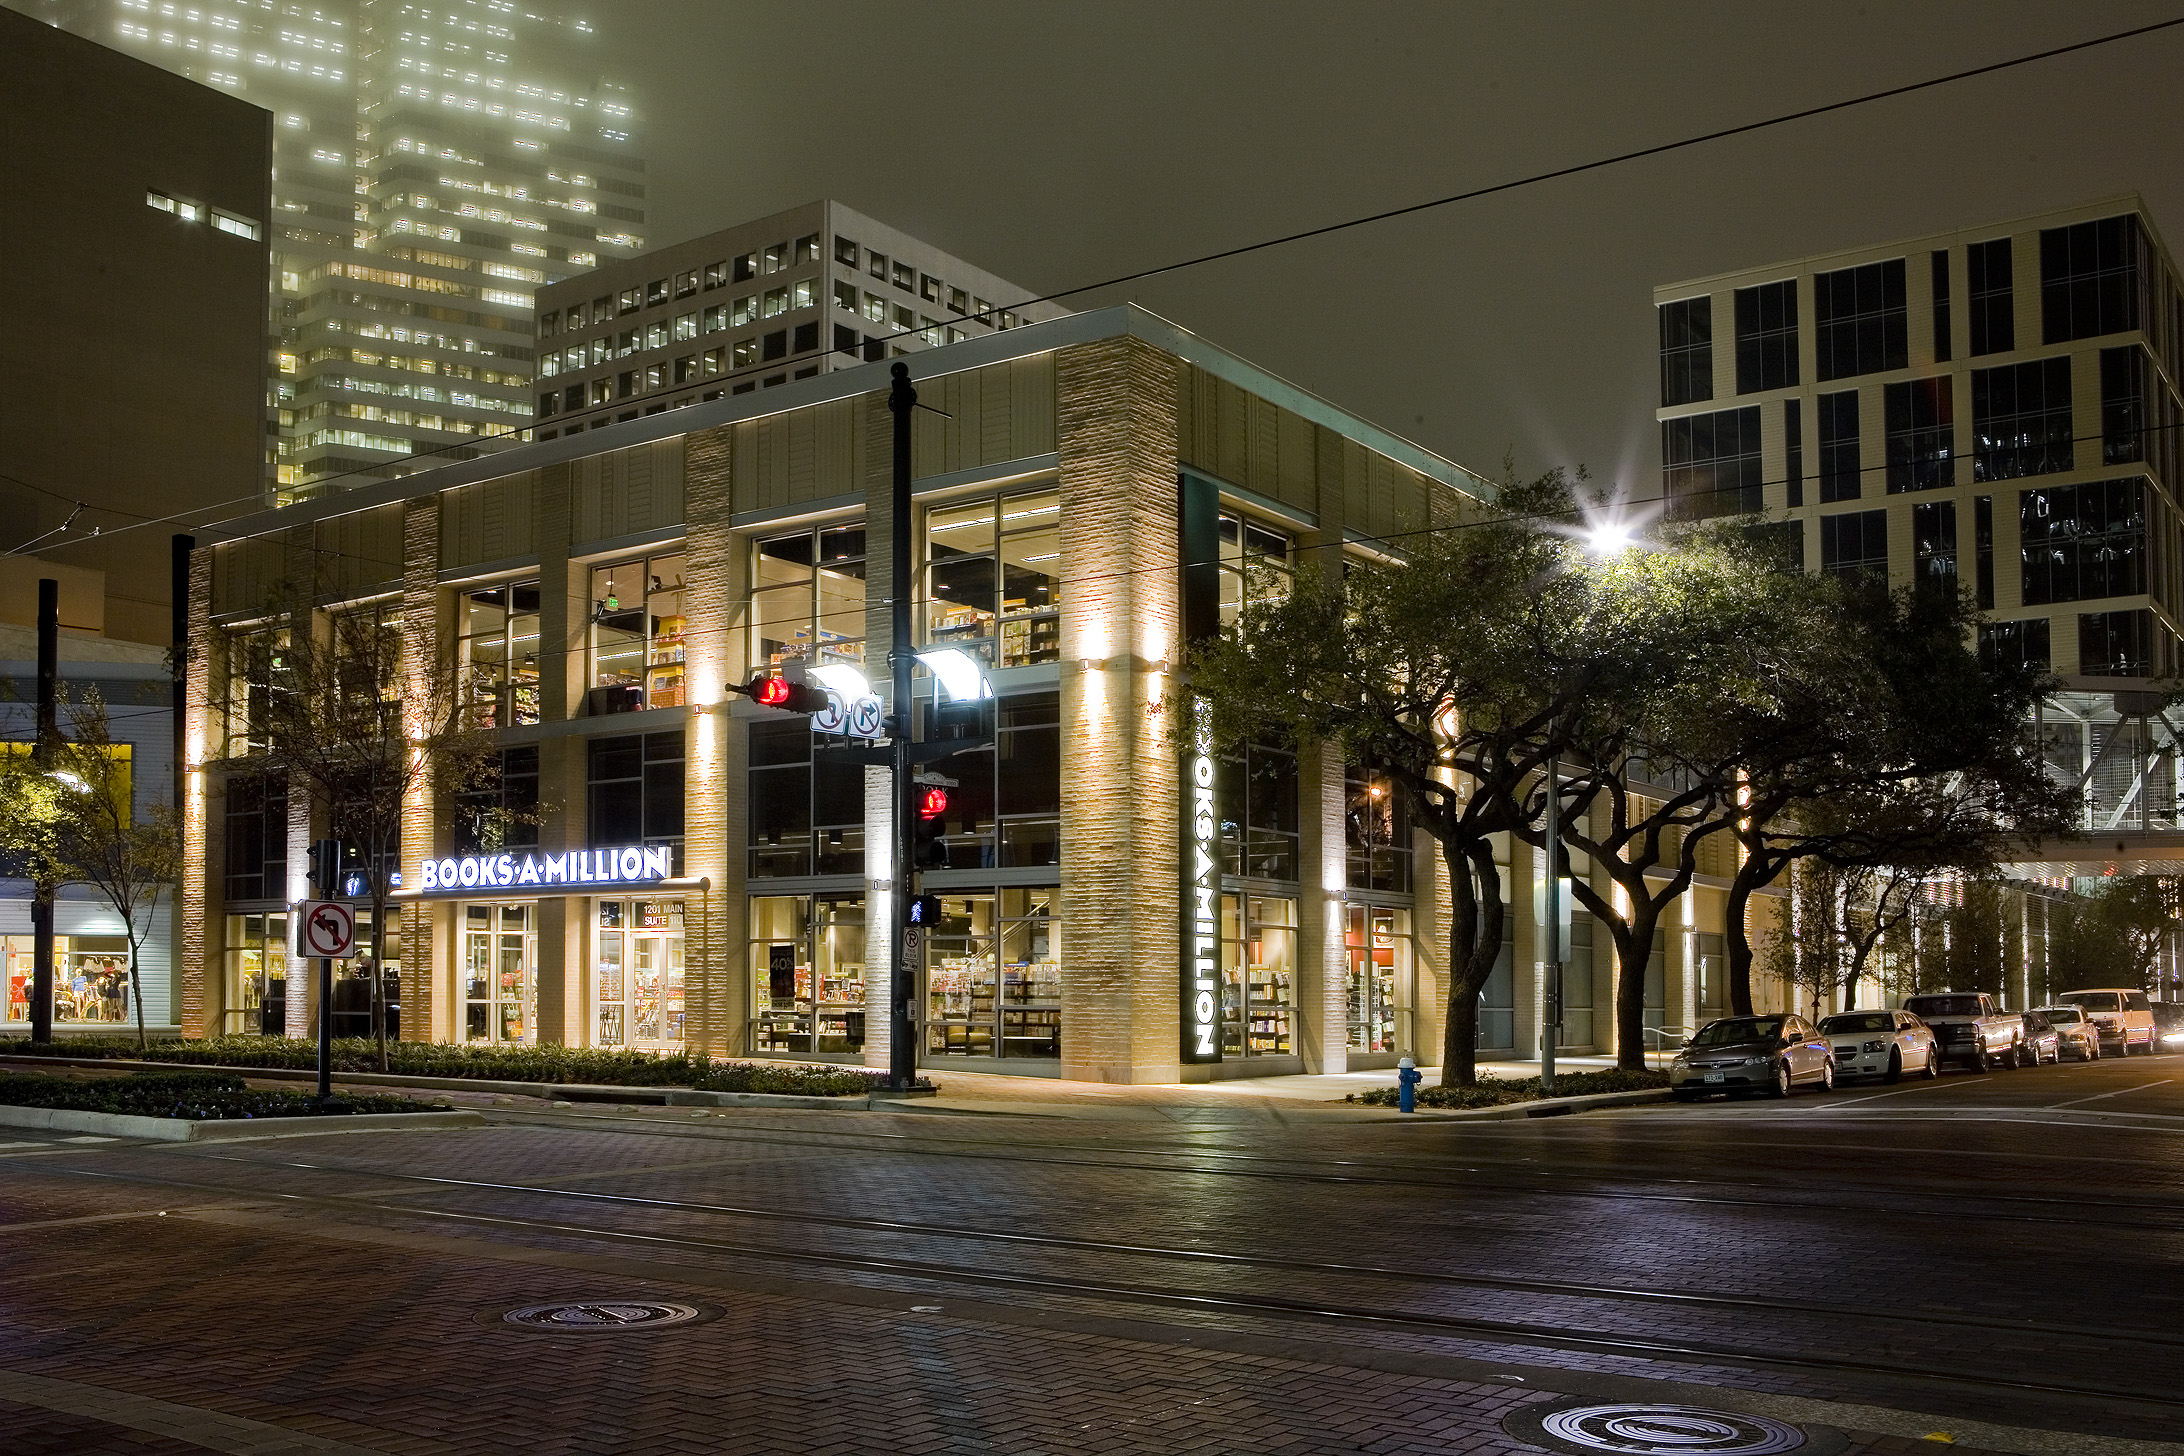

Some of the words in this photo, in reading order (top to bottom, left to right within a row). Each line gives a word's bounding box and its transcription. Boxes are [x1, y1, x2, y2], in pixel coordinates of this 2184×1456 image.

[1194, 695, 1214, 1055] OOKS·A·MILLION
[644, 904, 661, 914] 1201
[663, 903, 683, 914] MAIN
[644, 915, 667, 926] SUITE
[669, 915, 683, 925] 110
